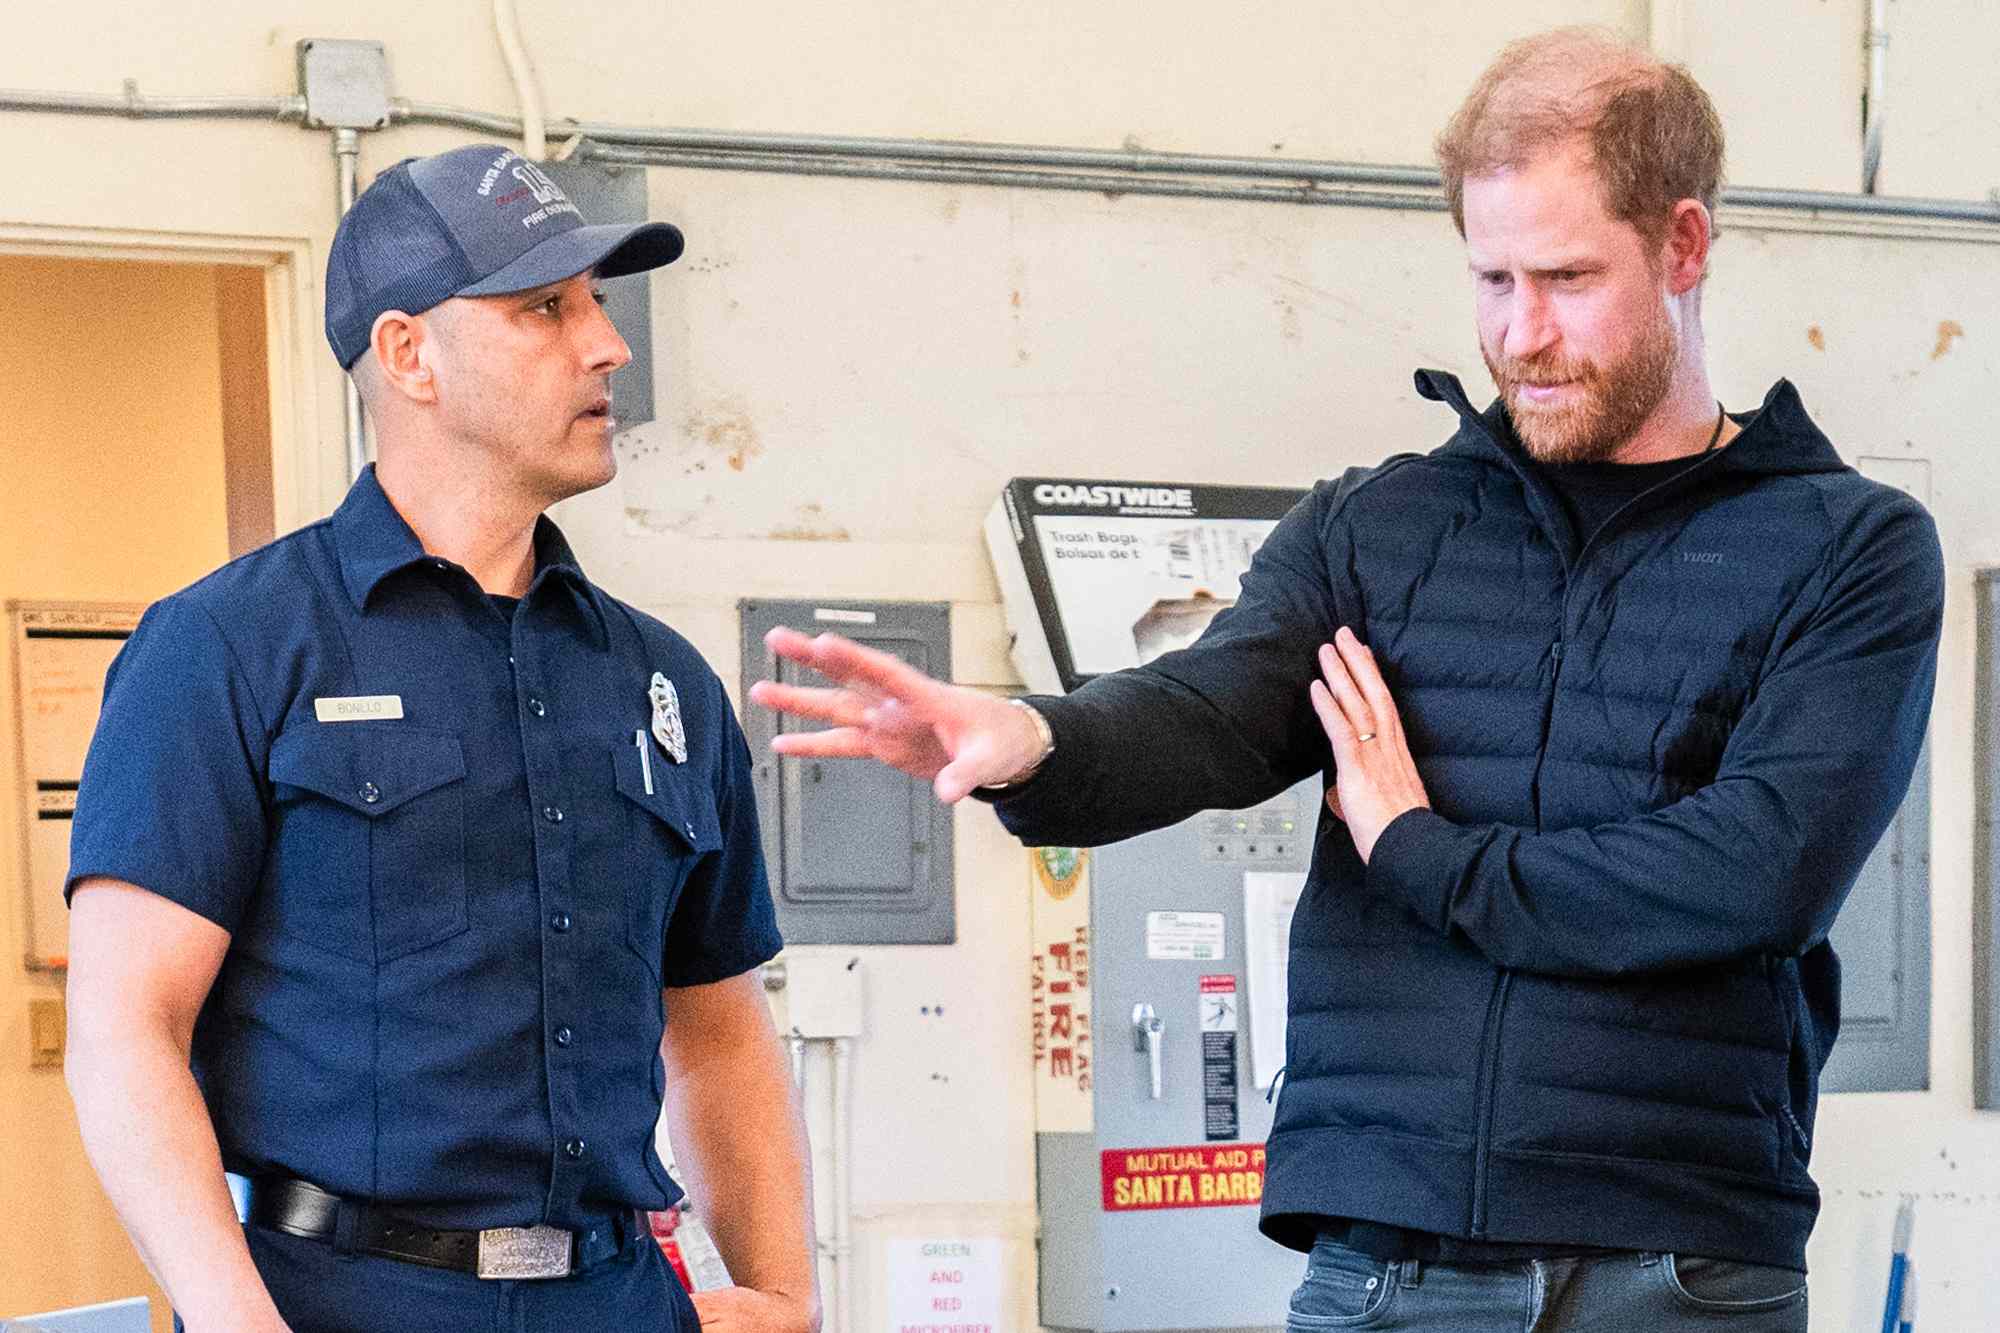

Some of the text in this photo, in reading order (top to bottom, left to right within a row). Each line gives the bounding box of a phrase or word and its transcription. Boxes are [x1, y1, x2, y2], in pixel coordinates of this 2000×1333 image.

[477, 167, 502, 197] SANTA
[522, 207, 549, 229] FIRE
[1033, 484, 1193, 507] COASTWIDE
[1048, 531, 1094, 544] Trash
[1055, 546, 1105, 560] Bolsas
[1031, 954, 1046, 1069] PATROL
[1049, 942, 1073, 1078] FIRE
[1076, 1013, 1092, 1093] FLAG
[1126, 1152, 1209, 1172] MUTUAL
[1213, 1149, 1248, 1169] AID
[1114, 1171, 1264, 1205] SANTA BARB
[921, 1243, 971, 1257] GREEN
[929, 1270, 962, 1284] AND
[931, 1297, 962, 1311] RED
